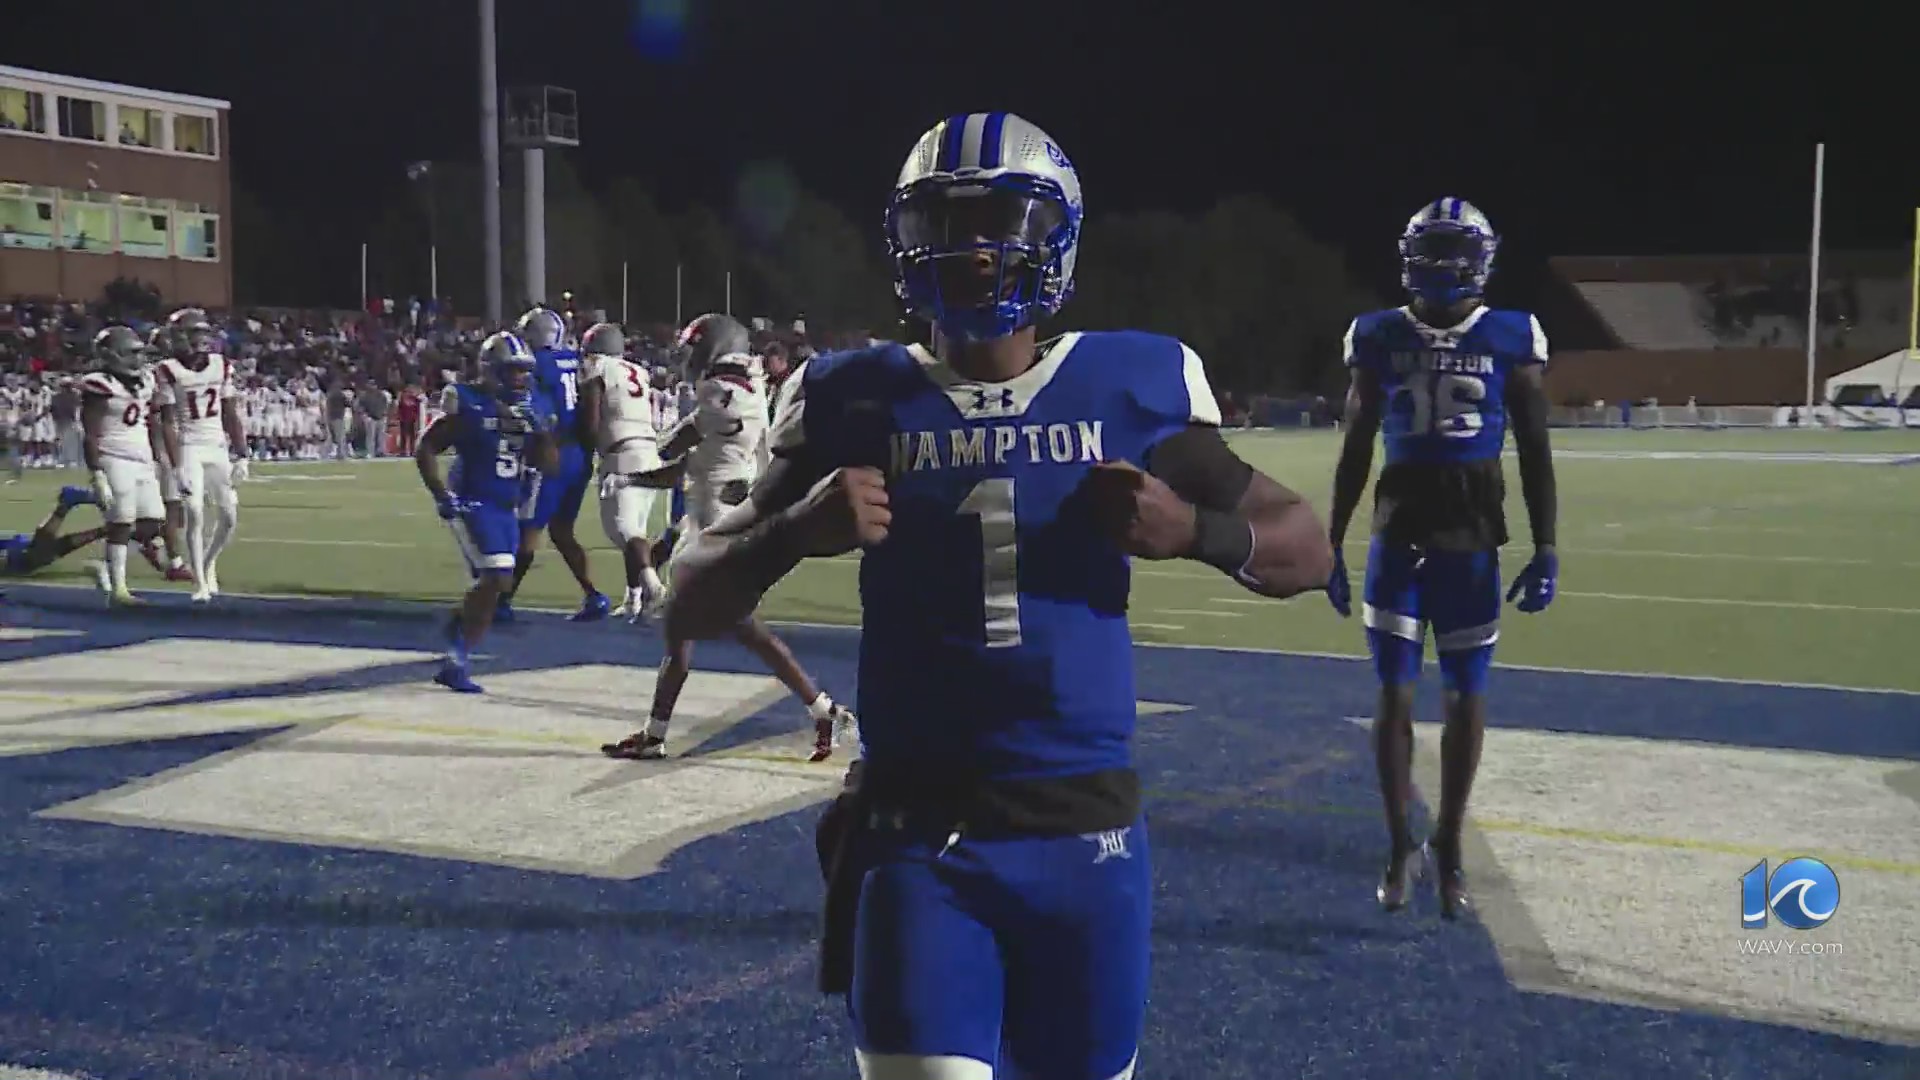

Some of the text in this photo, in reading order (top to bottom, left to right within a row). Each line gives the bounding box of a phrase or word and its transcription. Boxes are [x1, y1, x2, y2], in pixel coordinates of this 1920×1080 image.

[186, 387, 218, 420] 12
[890, 420, 1104, 473] HAMPTON
[955, 477, 1022, 648] 1
